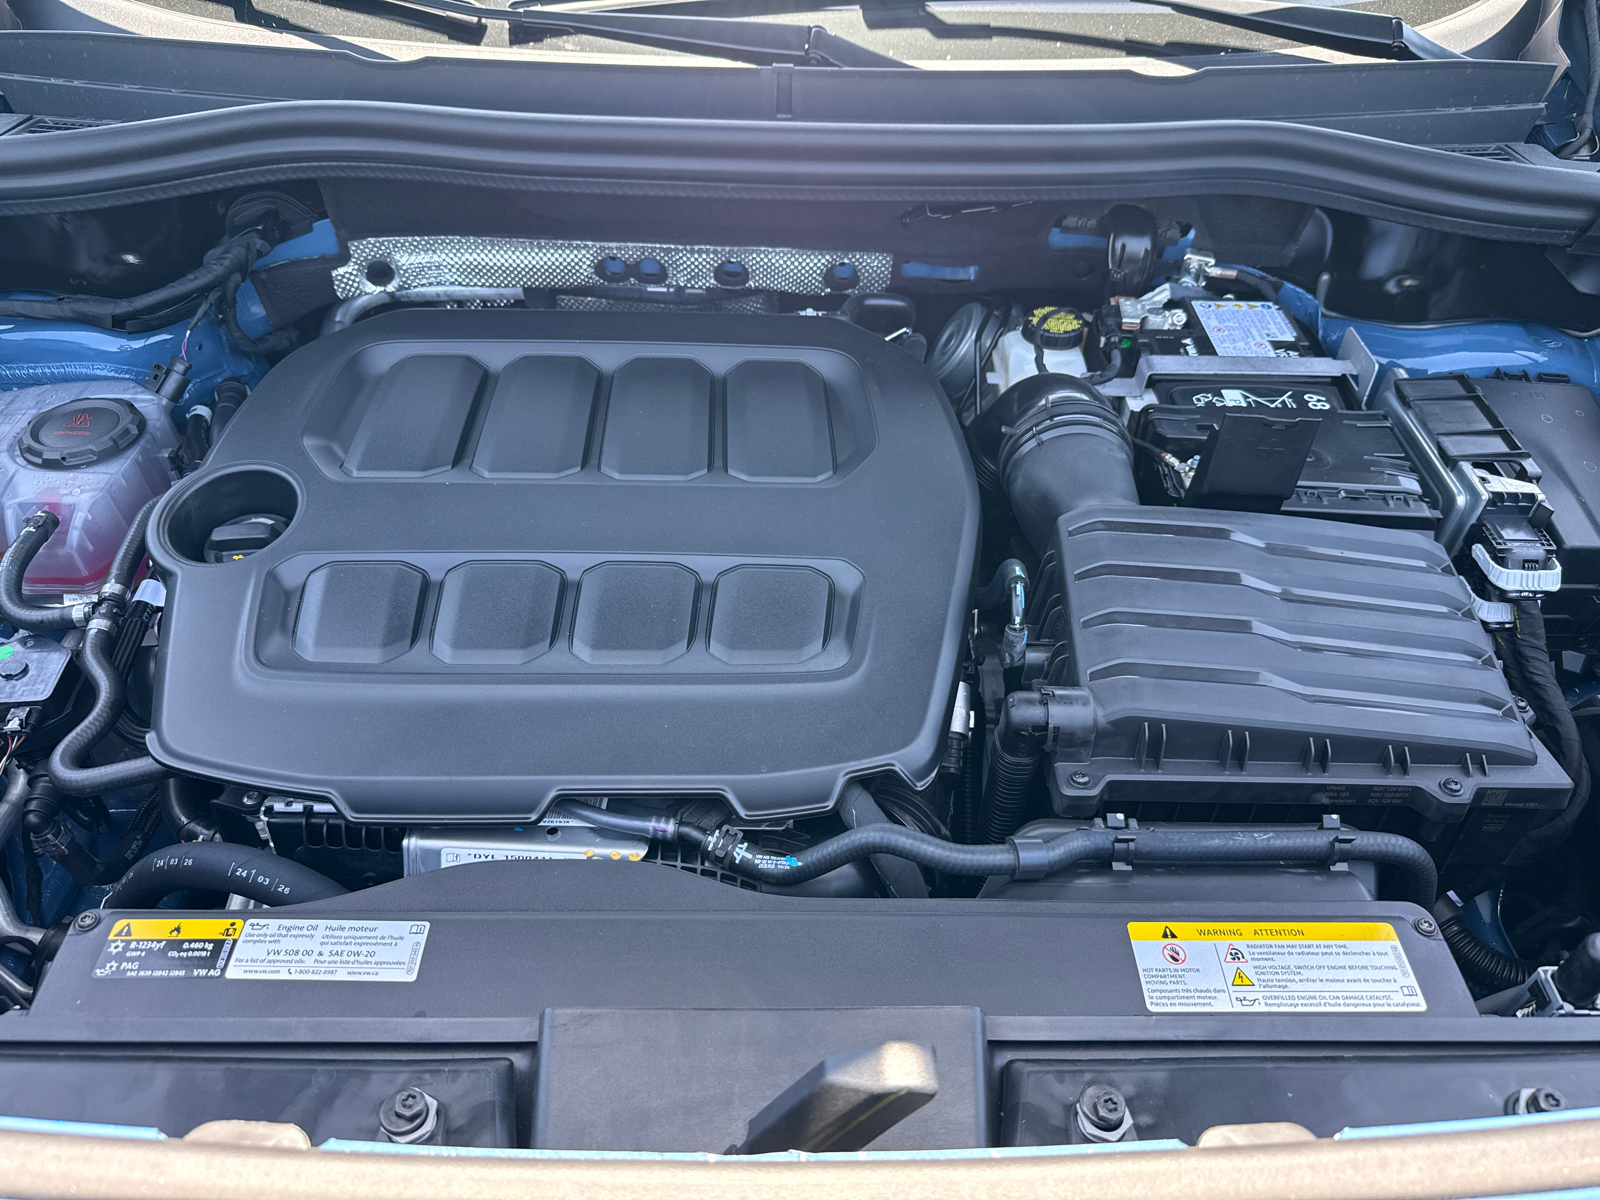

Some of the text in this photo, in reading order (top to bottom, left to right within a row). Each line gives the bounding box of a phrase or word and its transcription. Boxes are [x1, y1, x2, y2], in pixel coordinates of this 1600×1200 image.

[236, 867, 291, 895] 24 03 26
[277, 924, 305, 932] Engine
[129, 941, 166, 951] R-1234yf
[301, 949, 314, 957] 00
[120, 962, 139, 970] PAG
